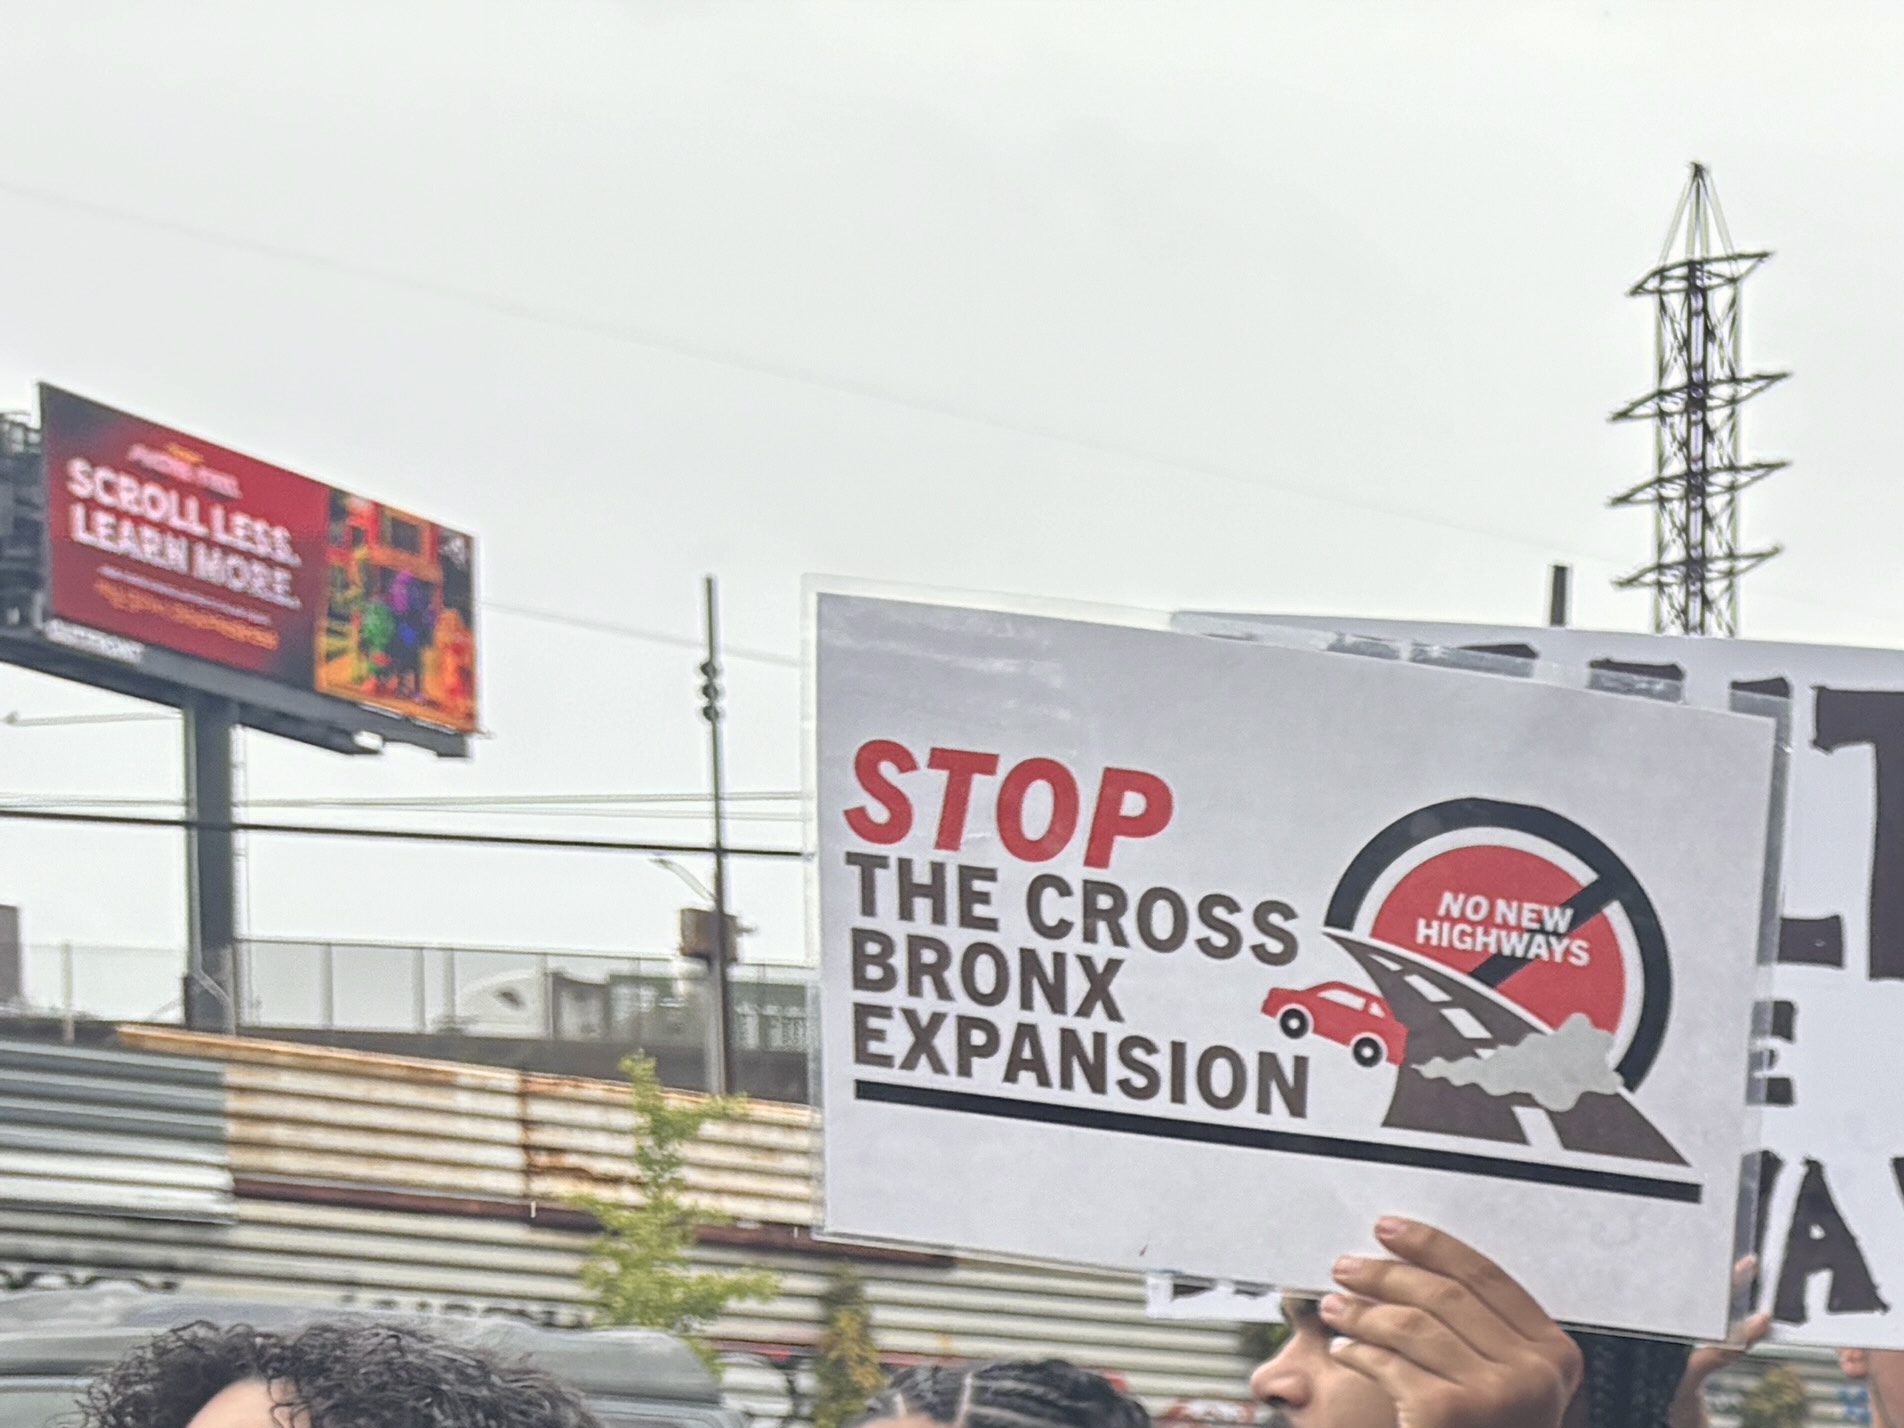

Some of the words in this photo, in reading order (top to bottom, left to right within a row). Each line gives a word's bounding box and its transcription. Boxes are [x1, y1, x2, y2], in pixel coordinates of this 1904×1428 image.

[67, 457, 208, 538] SCROLL
[69, 502, 189, 576] LEARN
[843, 739, 1174, 869] STOP
[845, 851, 999, 932] THE
[1026, 872, 1299, 967] CROSS
[1415, 917, 1591, 967] HIGHWAYS
[1437, 890, 1491, 923] NO
[1494, 897, 1576, 934] NEW
[851, 927, 1125, 1024] BRONX
[853, 1002, 1310, 1120] EXPANSION
